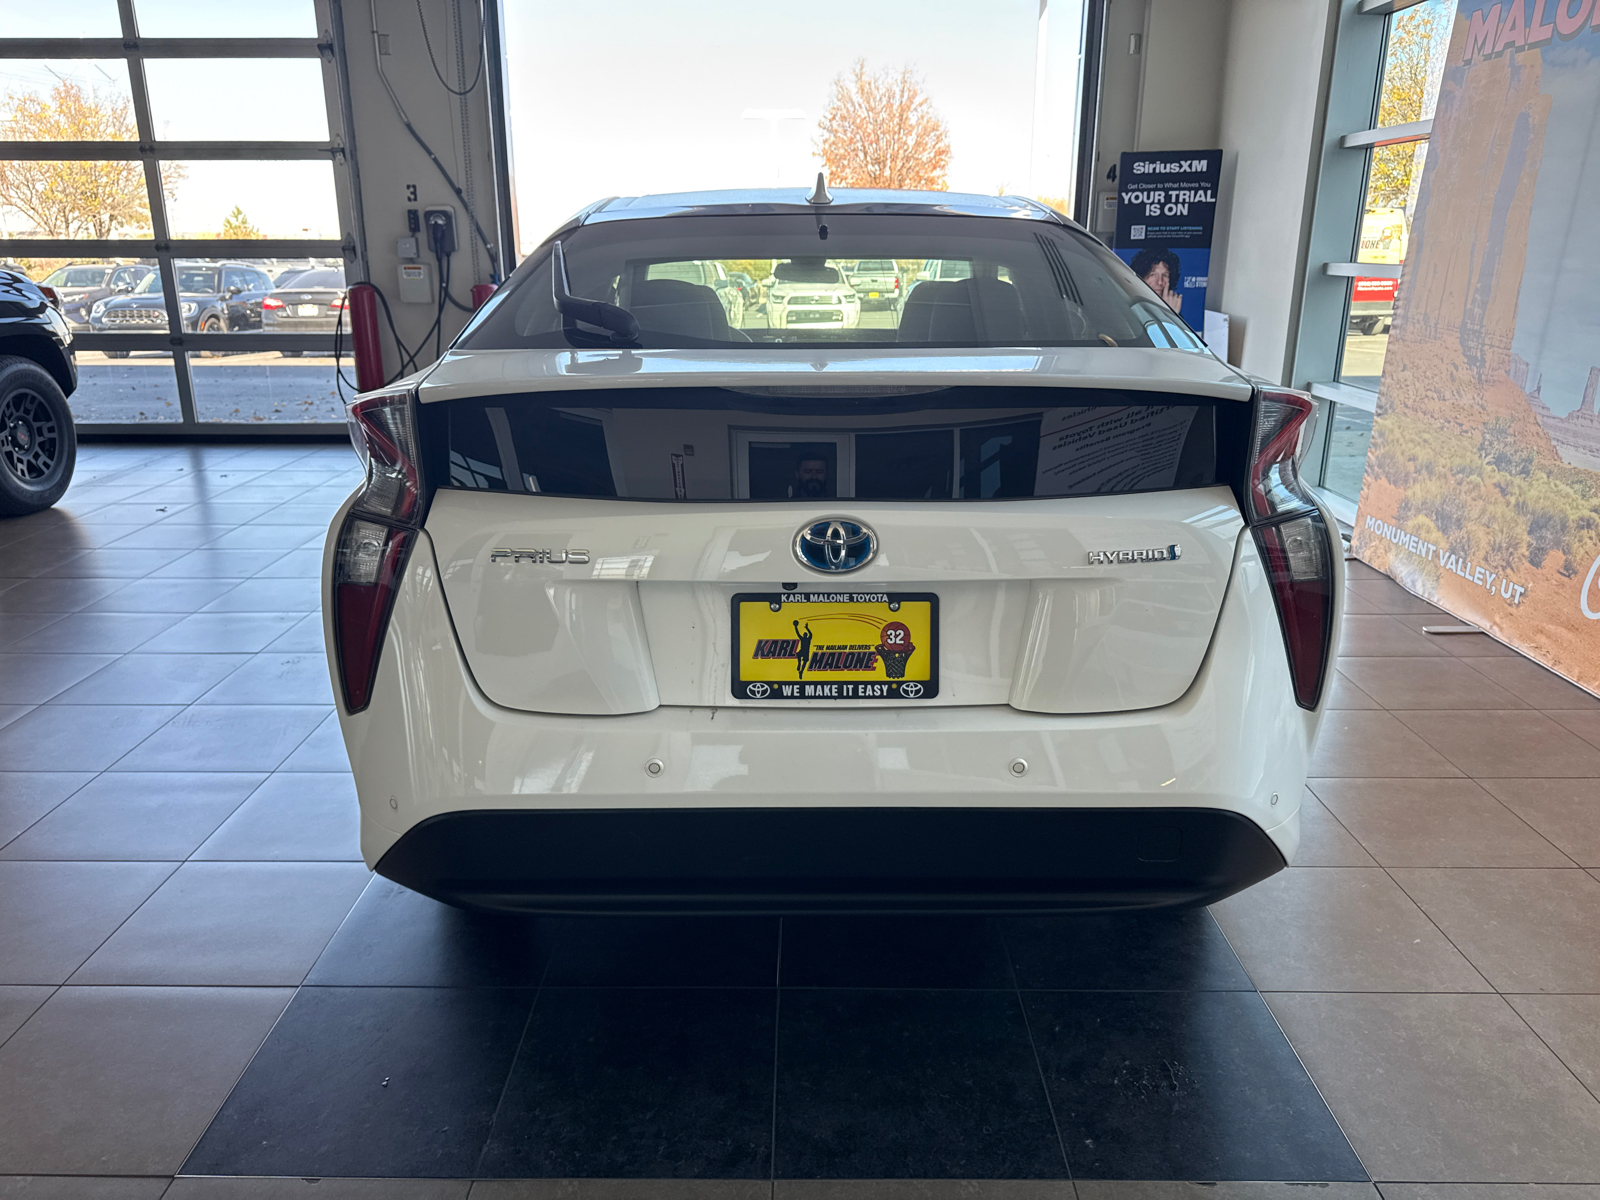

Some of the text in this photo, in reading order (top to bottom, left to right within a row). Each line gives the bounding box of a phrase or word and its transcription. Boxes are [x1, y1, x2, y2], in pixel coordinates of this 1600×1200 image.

[1462, 0, 1600, 66] MALO
[1106, 164, 1118, 183] 4
[1132, 160, 1208, 174] SiriusXM
[406, 184, 418, 202] 3
[1121, 191, 1166, 204] YOUR
[1168, 190, 1216, 203] TRIAL
[1145, 203, 1189, 217] IS ON
[1361, 240, 1380, 249] LONE
[491, 548, 590, 564] PRIUS
[1088, 548, 1168, 565] HYBRID
[1365, 514, 1436, 561] MONUMENT
[1439, 548, 1497, 596] VALLEY,
[1500, 578, 1525, 604] UT
[781, 594, 889, 603] KARL MALONE TOYOTA
[886, 629, 905, 645] 32
[752, 639, 800, 659] KARL
[807, 651, 879, 671] MALONE
[782, 684, 888, 696] WE MAKE IT EASY
